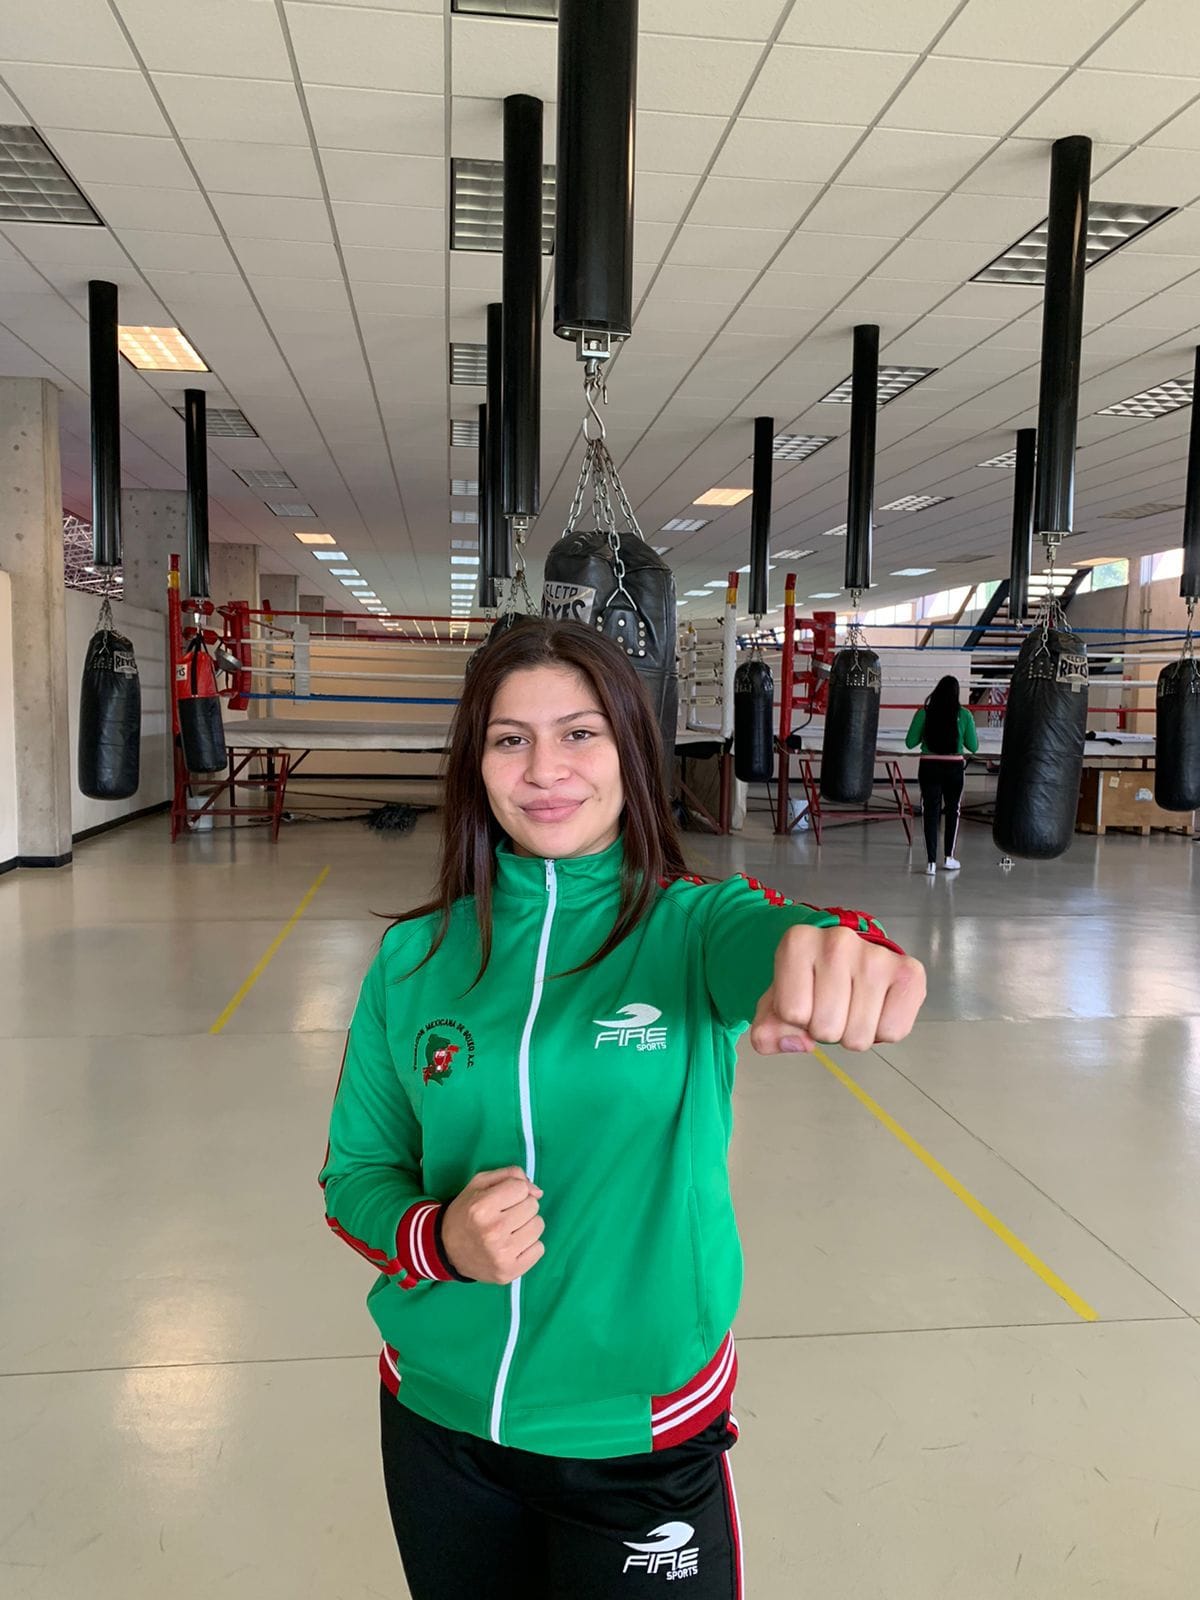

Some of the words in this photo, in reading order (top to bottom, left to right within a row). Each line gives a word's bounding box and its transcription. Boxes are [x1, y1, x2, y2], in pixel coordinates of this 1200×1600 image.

[594, 1027, 668, 1050] FIRE
[636, 1041, 667, 1052] SPORTS
[622, 1547, 700, 1574] FIRE
[666, 1565, 698, 1581] SPORTS
